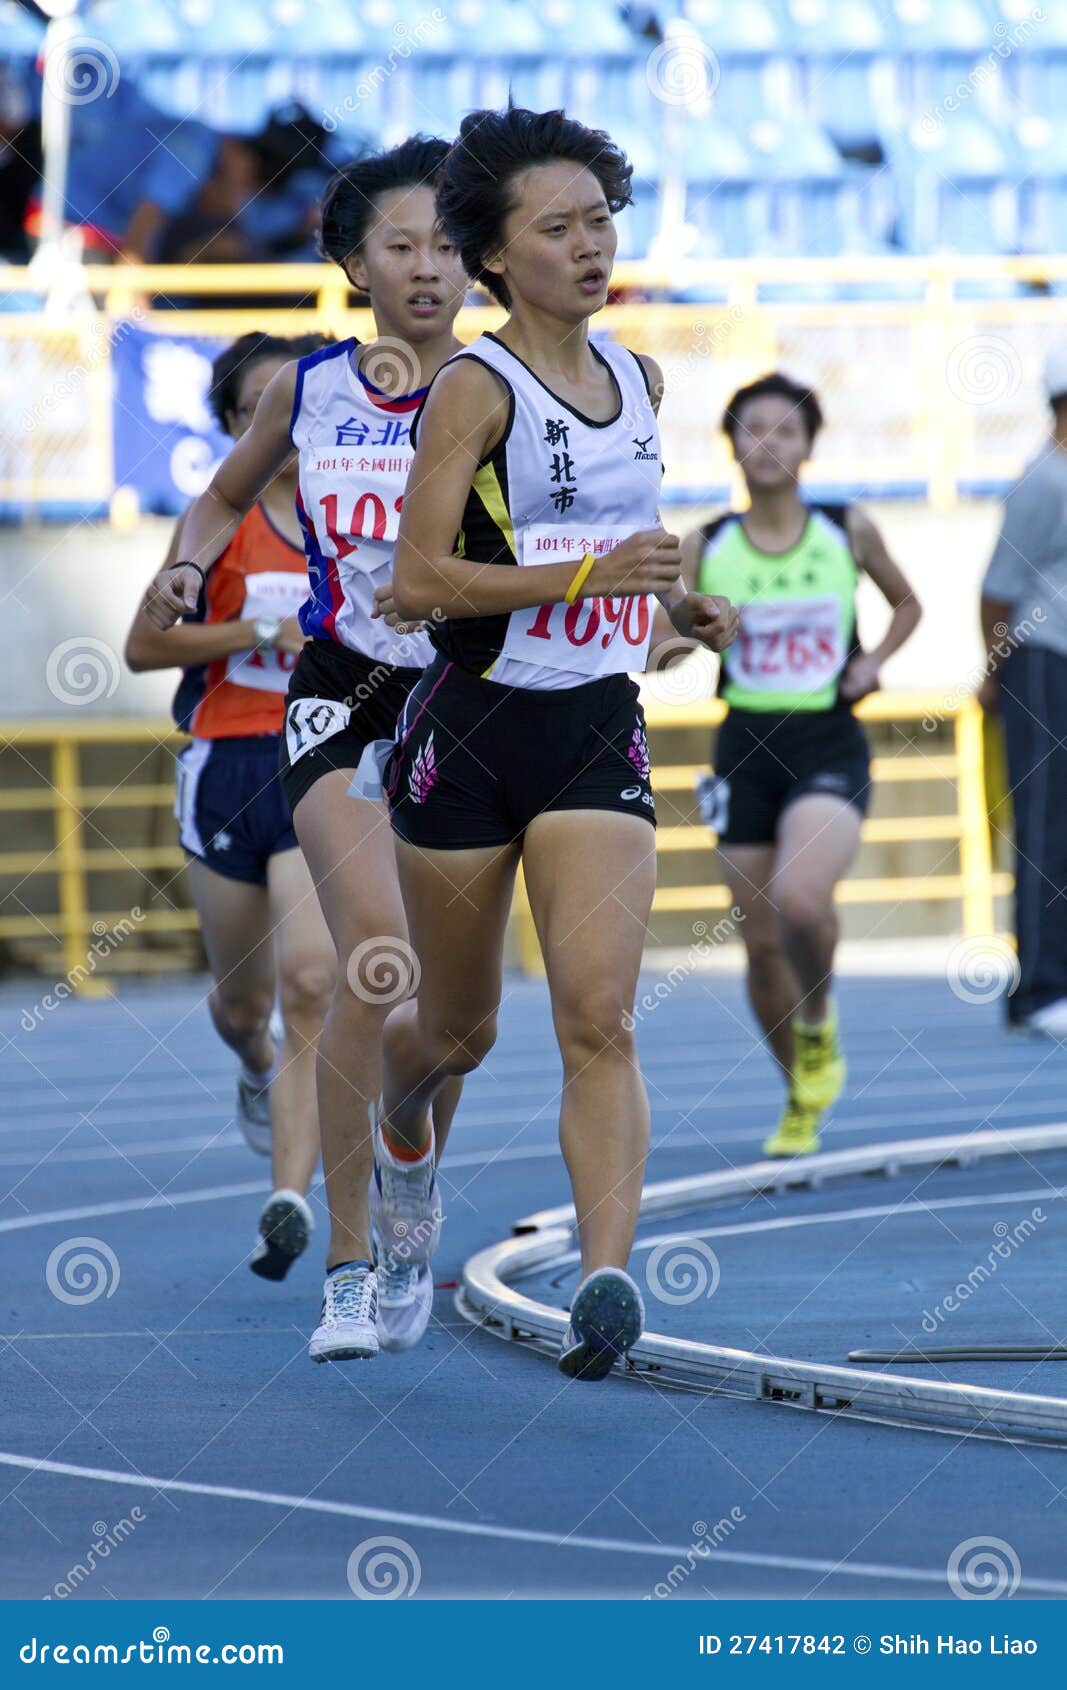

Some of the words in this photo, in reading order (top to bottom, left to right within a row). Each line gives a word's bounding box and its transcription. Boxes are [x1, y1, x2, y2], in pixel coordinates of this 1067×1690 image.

[544, 418, 577, 514] 新北市
[319, 492, 404, 560] 10
